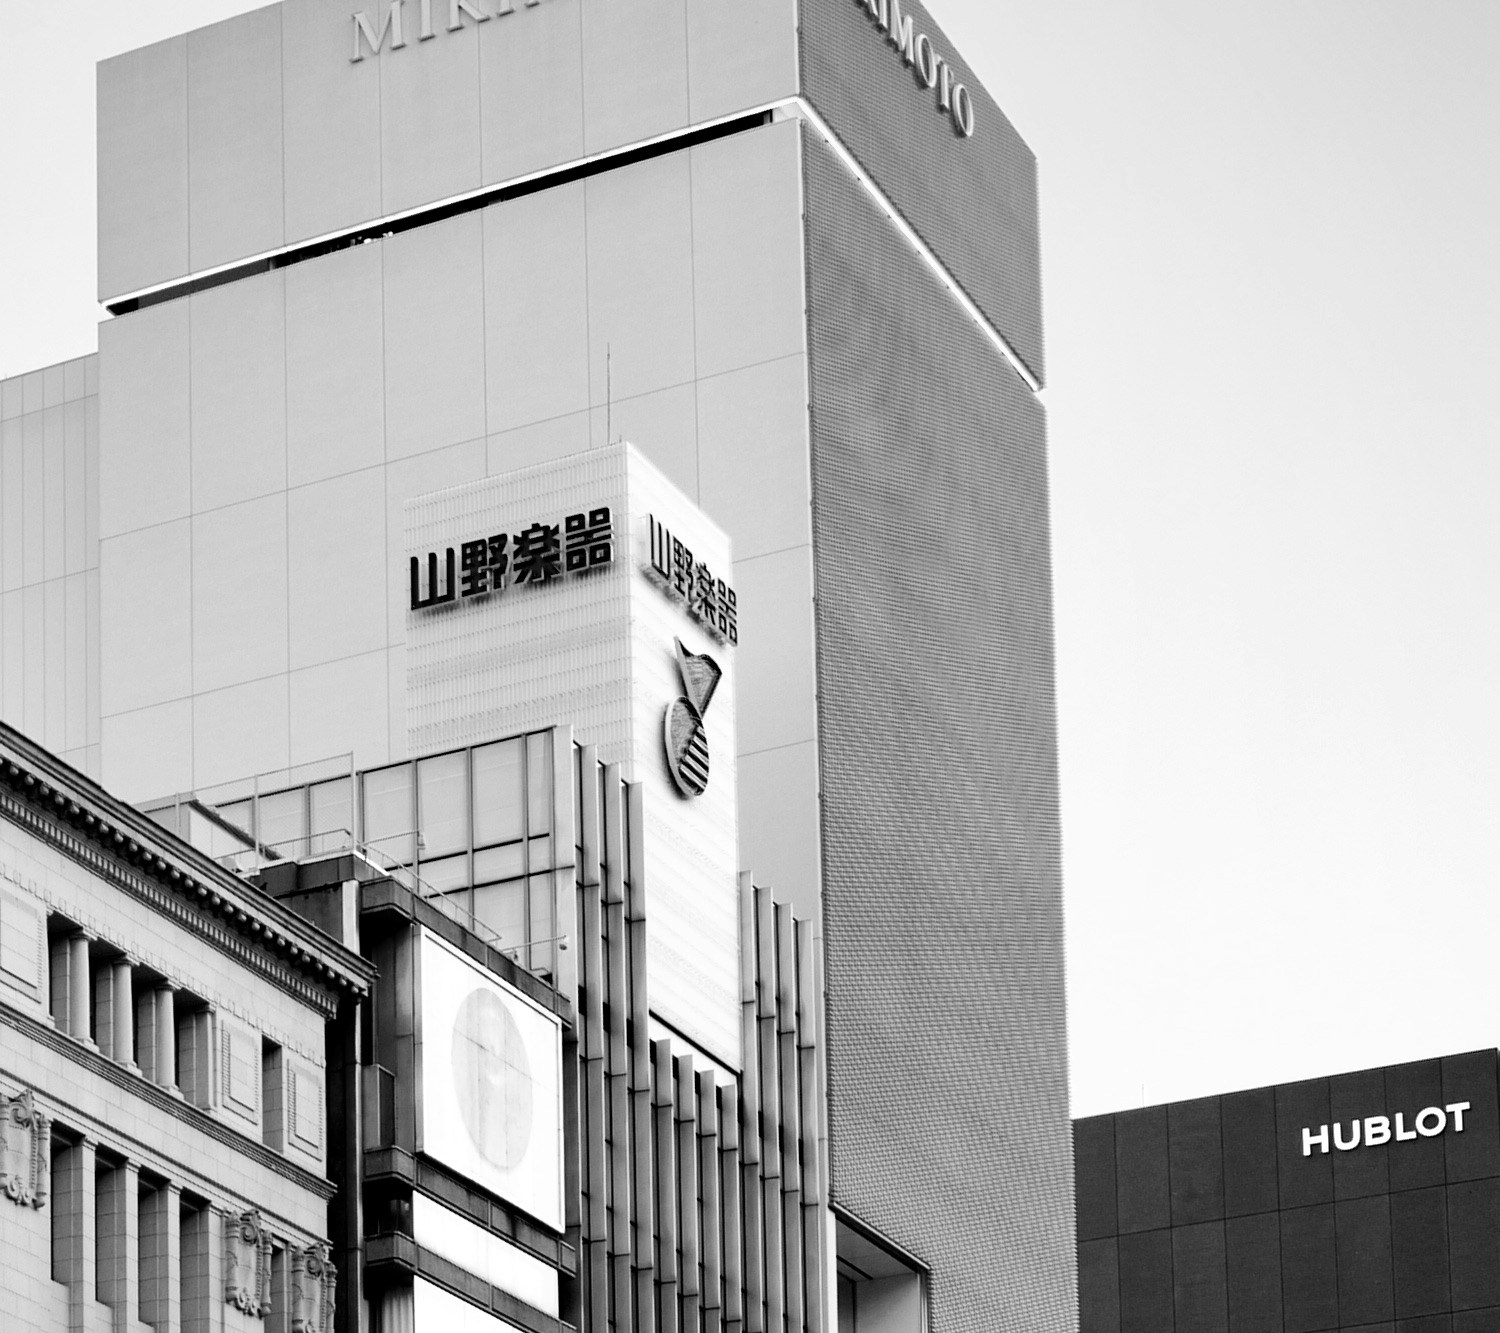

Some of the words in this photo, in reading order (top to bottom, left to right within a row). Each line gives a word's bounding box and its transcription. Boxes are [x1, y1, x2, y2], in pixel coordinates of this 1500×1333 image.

[349, 0, 541, 63] MIK
[410, 507, 613, 610] 山野楽器
[648, 513, 738, 646] 山野楽器
[1302, 1101, 1471, 1157] HUBLOT
